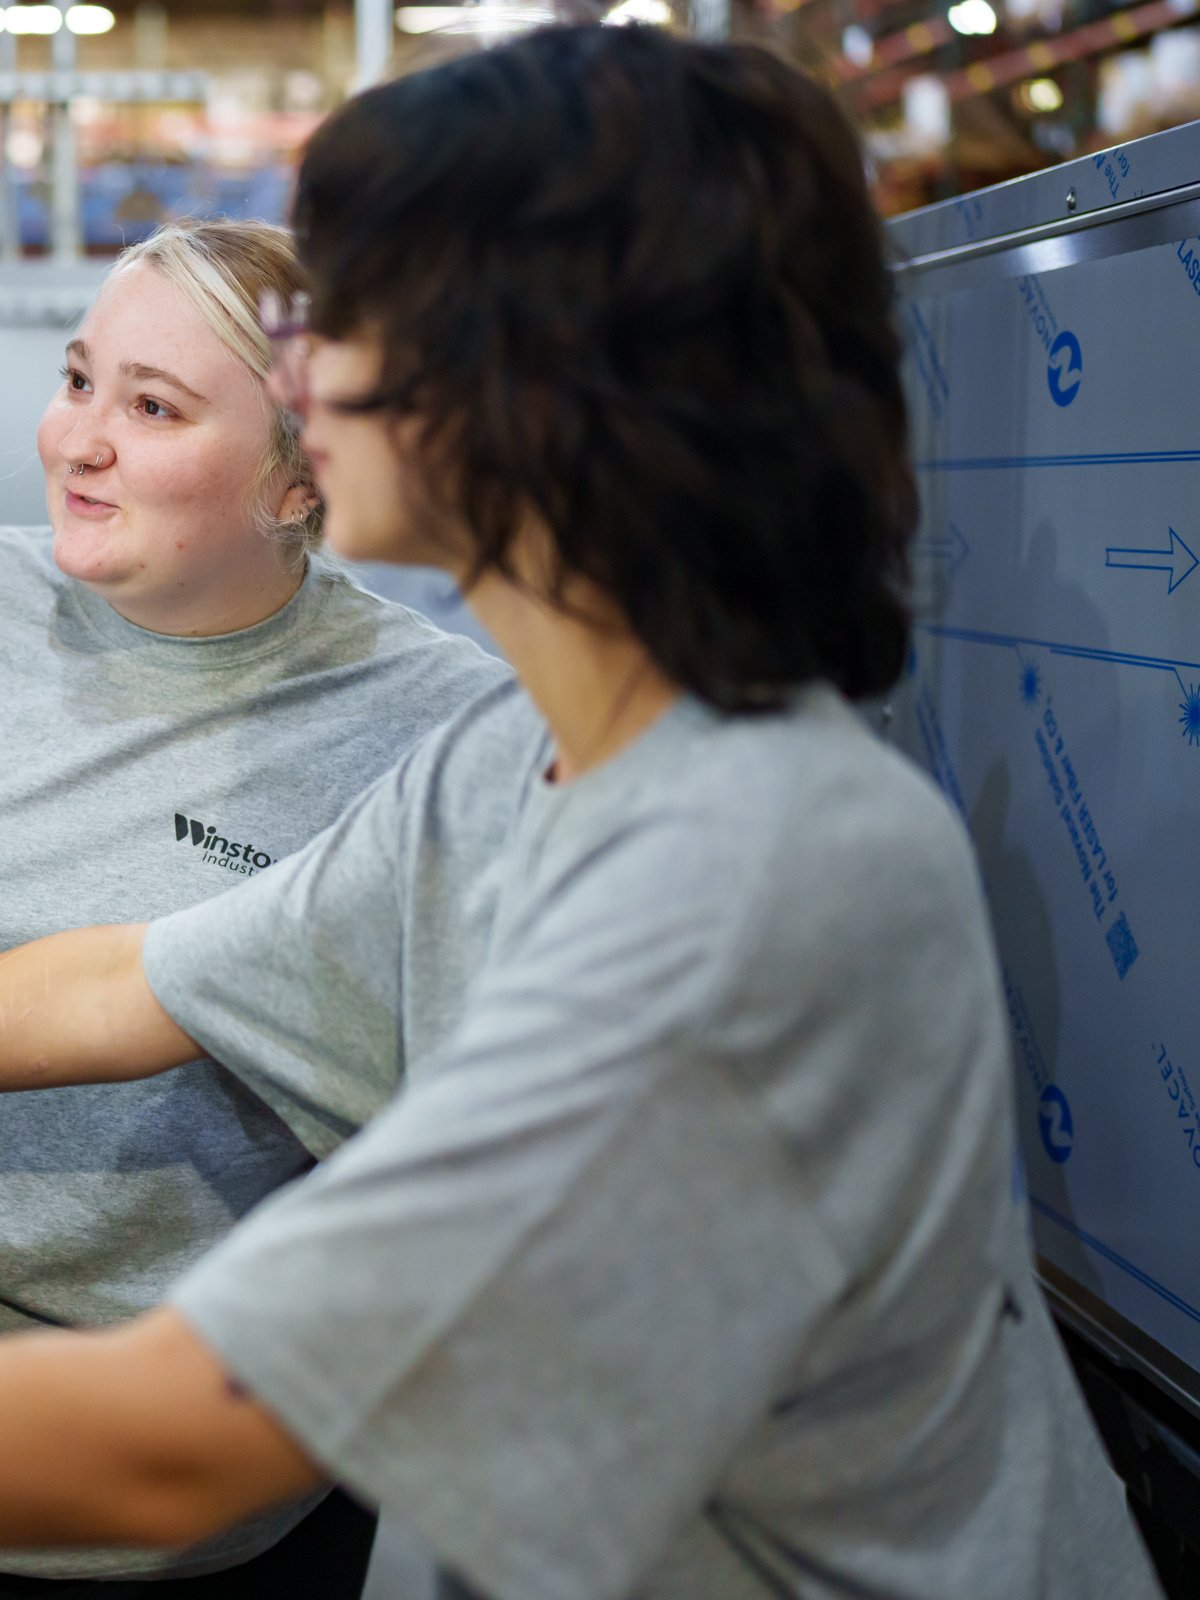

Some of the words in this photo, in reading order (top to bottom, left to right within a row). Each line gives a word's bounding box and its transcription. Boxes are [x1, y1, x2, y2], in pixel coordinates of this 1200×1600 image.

[1105, 164, 1119, 199] The
[1118, 153, 1130, 178] for
[1177, 239, 1200, 296] LASE
[174, 812, 279, 869] Winsto
[202, 851, 259, 877] indust
[1104, 869, 1118, 902] for
